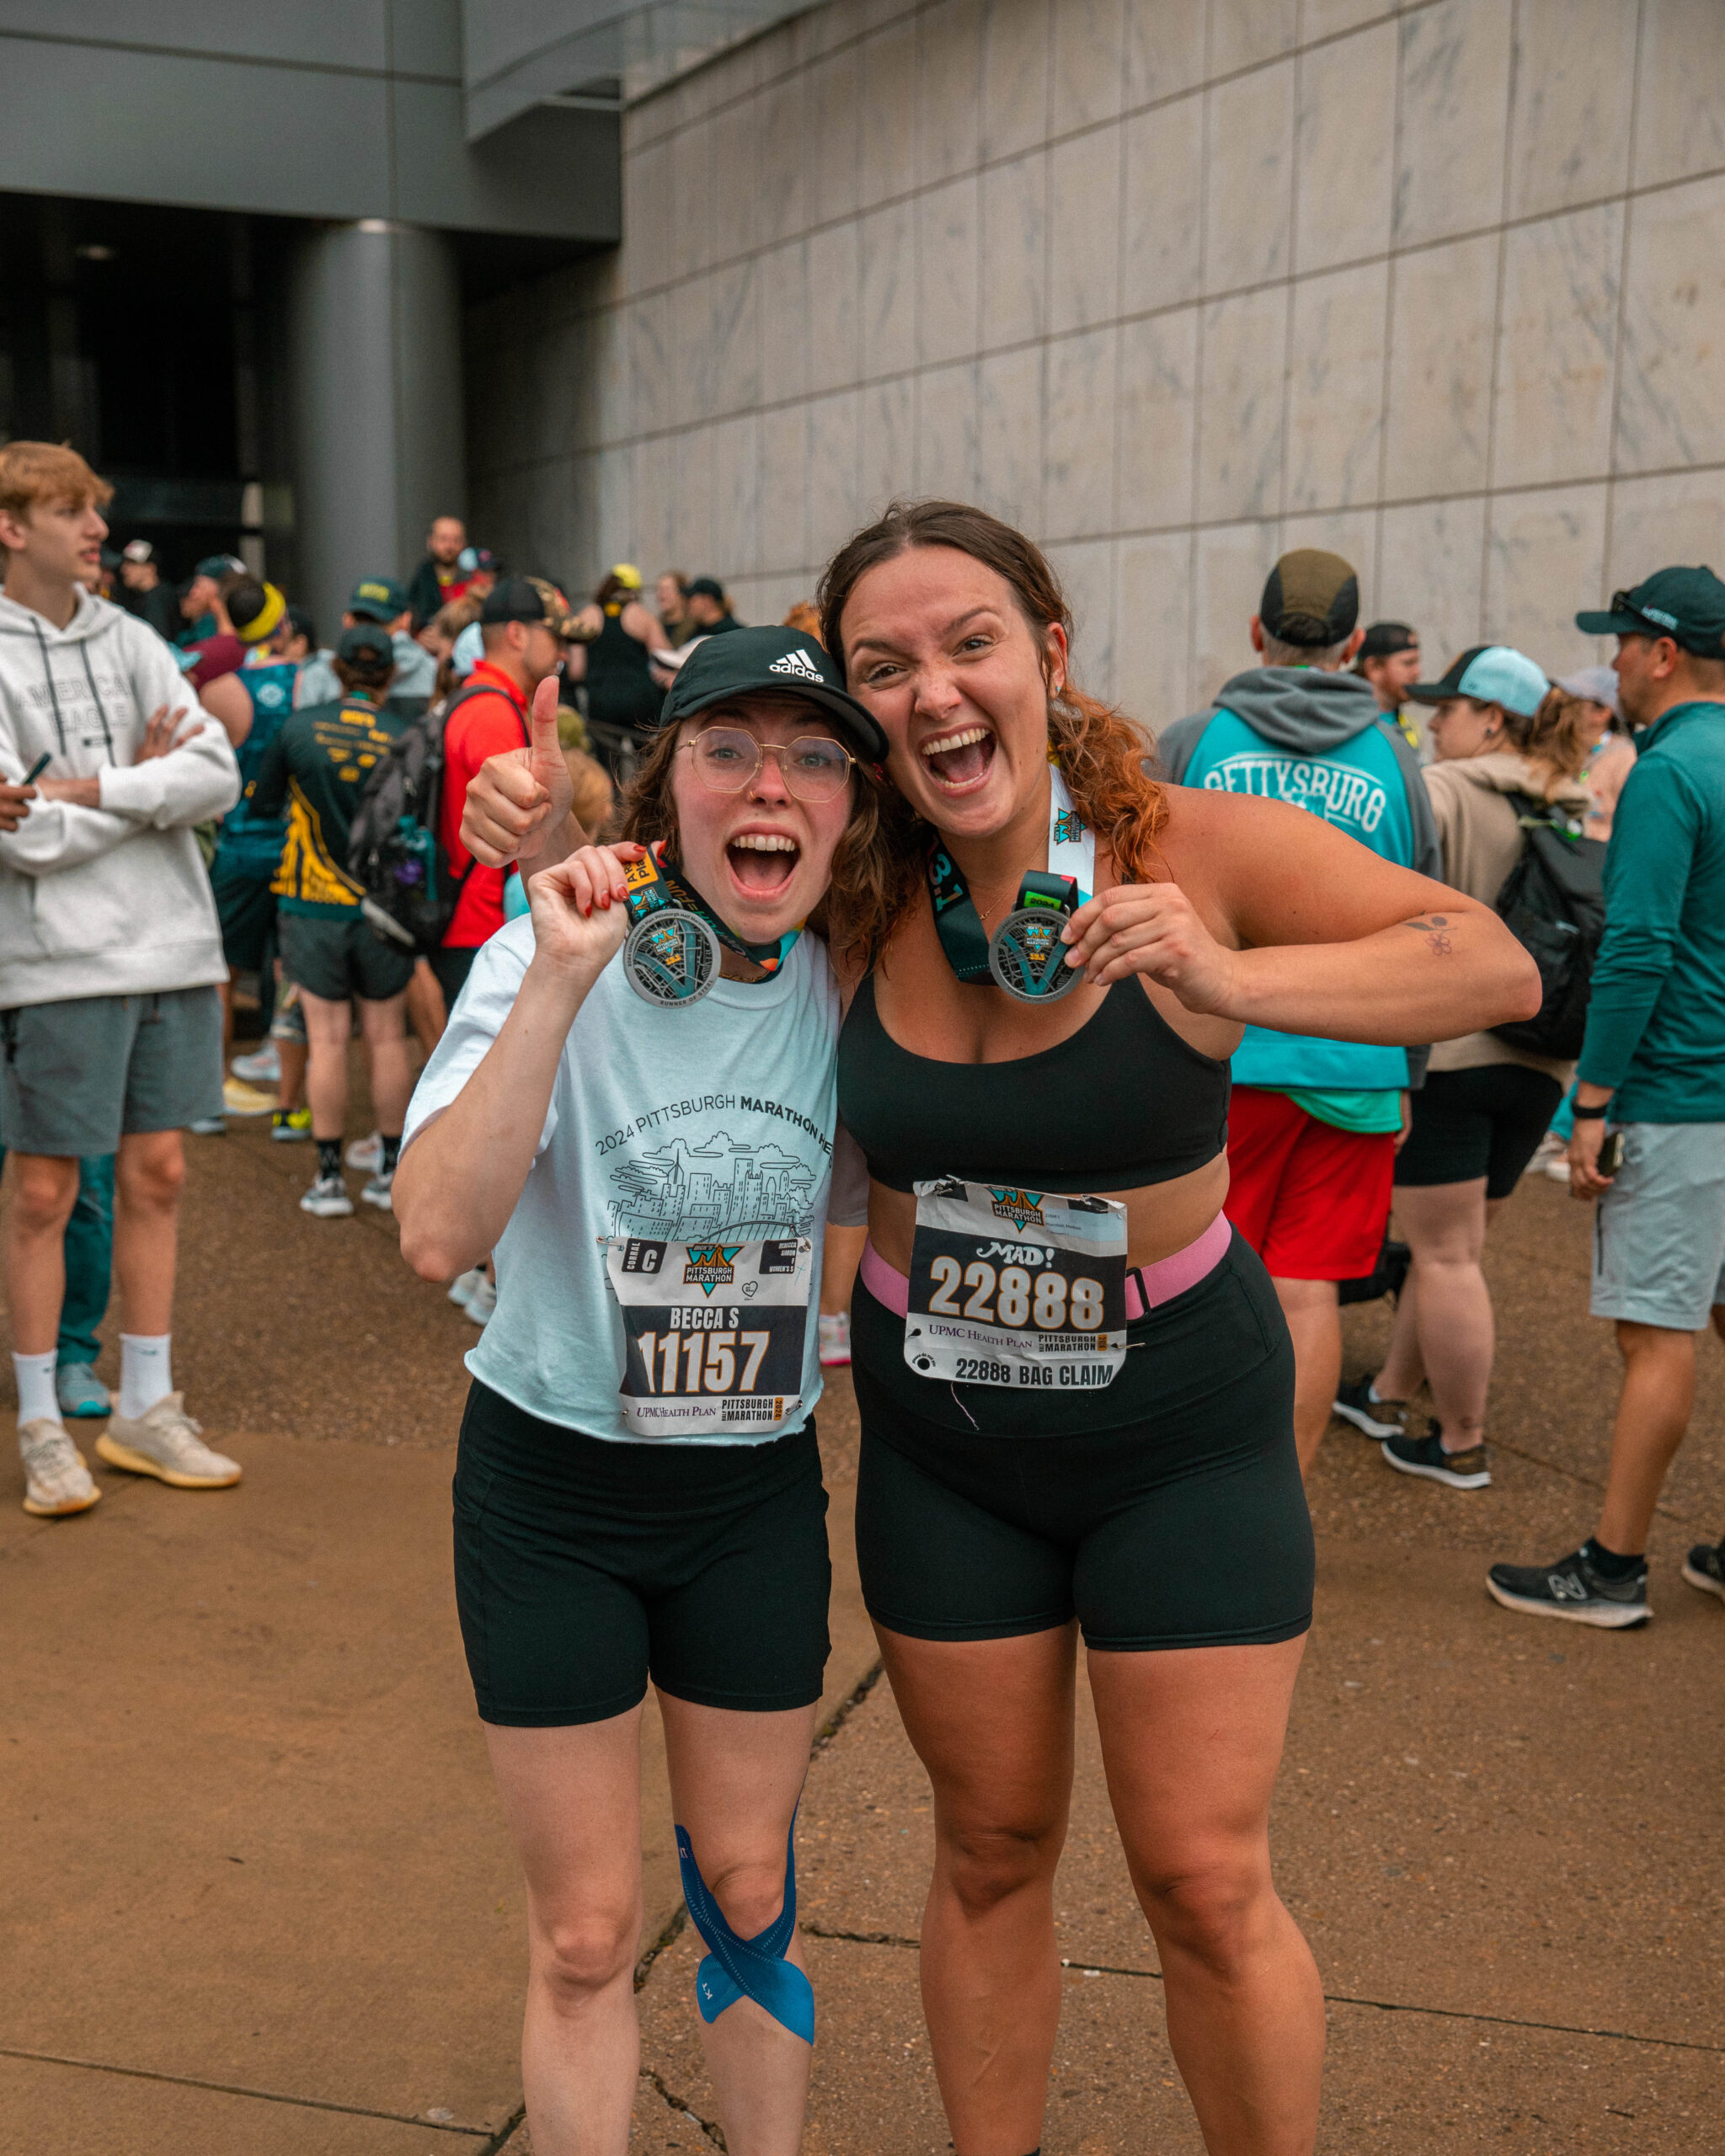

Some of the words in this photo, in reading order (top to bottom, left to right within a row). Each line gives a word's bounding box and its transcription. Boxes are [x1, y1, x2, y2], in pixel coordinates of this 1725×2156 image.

[769, 664, 824, 683] adidas
[595, 1123, 635, 1155] 2024
[635, 1095, 735, 1133] PITTSBURGH
[740, 1096, 819, 1139] MARATHON
[994, 1203, 1042, 1219] PITTSBURGH
[995, 1210, 1042, 1225] MARATHON
[627, 1242, 640, 1270] CORRAL
[642, 1249, 657, 1272] C
[686, 1274, 732, 1283] MARATHON
[929, 1255, 1104, 1330] 22888
[670, 1307, 723, 1329] BECCA
[729, 1307, 740, 1329] S
[929, 1324, 965, 1338] UPMC
[1039, 1334, 1097, 1343] PITTSBURGH
[1044, 1342, 1096, 1353] MARATHON
[638, 1331, 770, 1394] 11157
[955, 1358, 1011, 1384] 22888
[1019, 1364, 1053, 1385] BAG
[1059, 1364, 1114, 1386] CLAIM
[722, 1399, 773, 1410] PITTSBURGH
[727, 1411, 773, 1422] MARATHON
